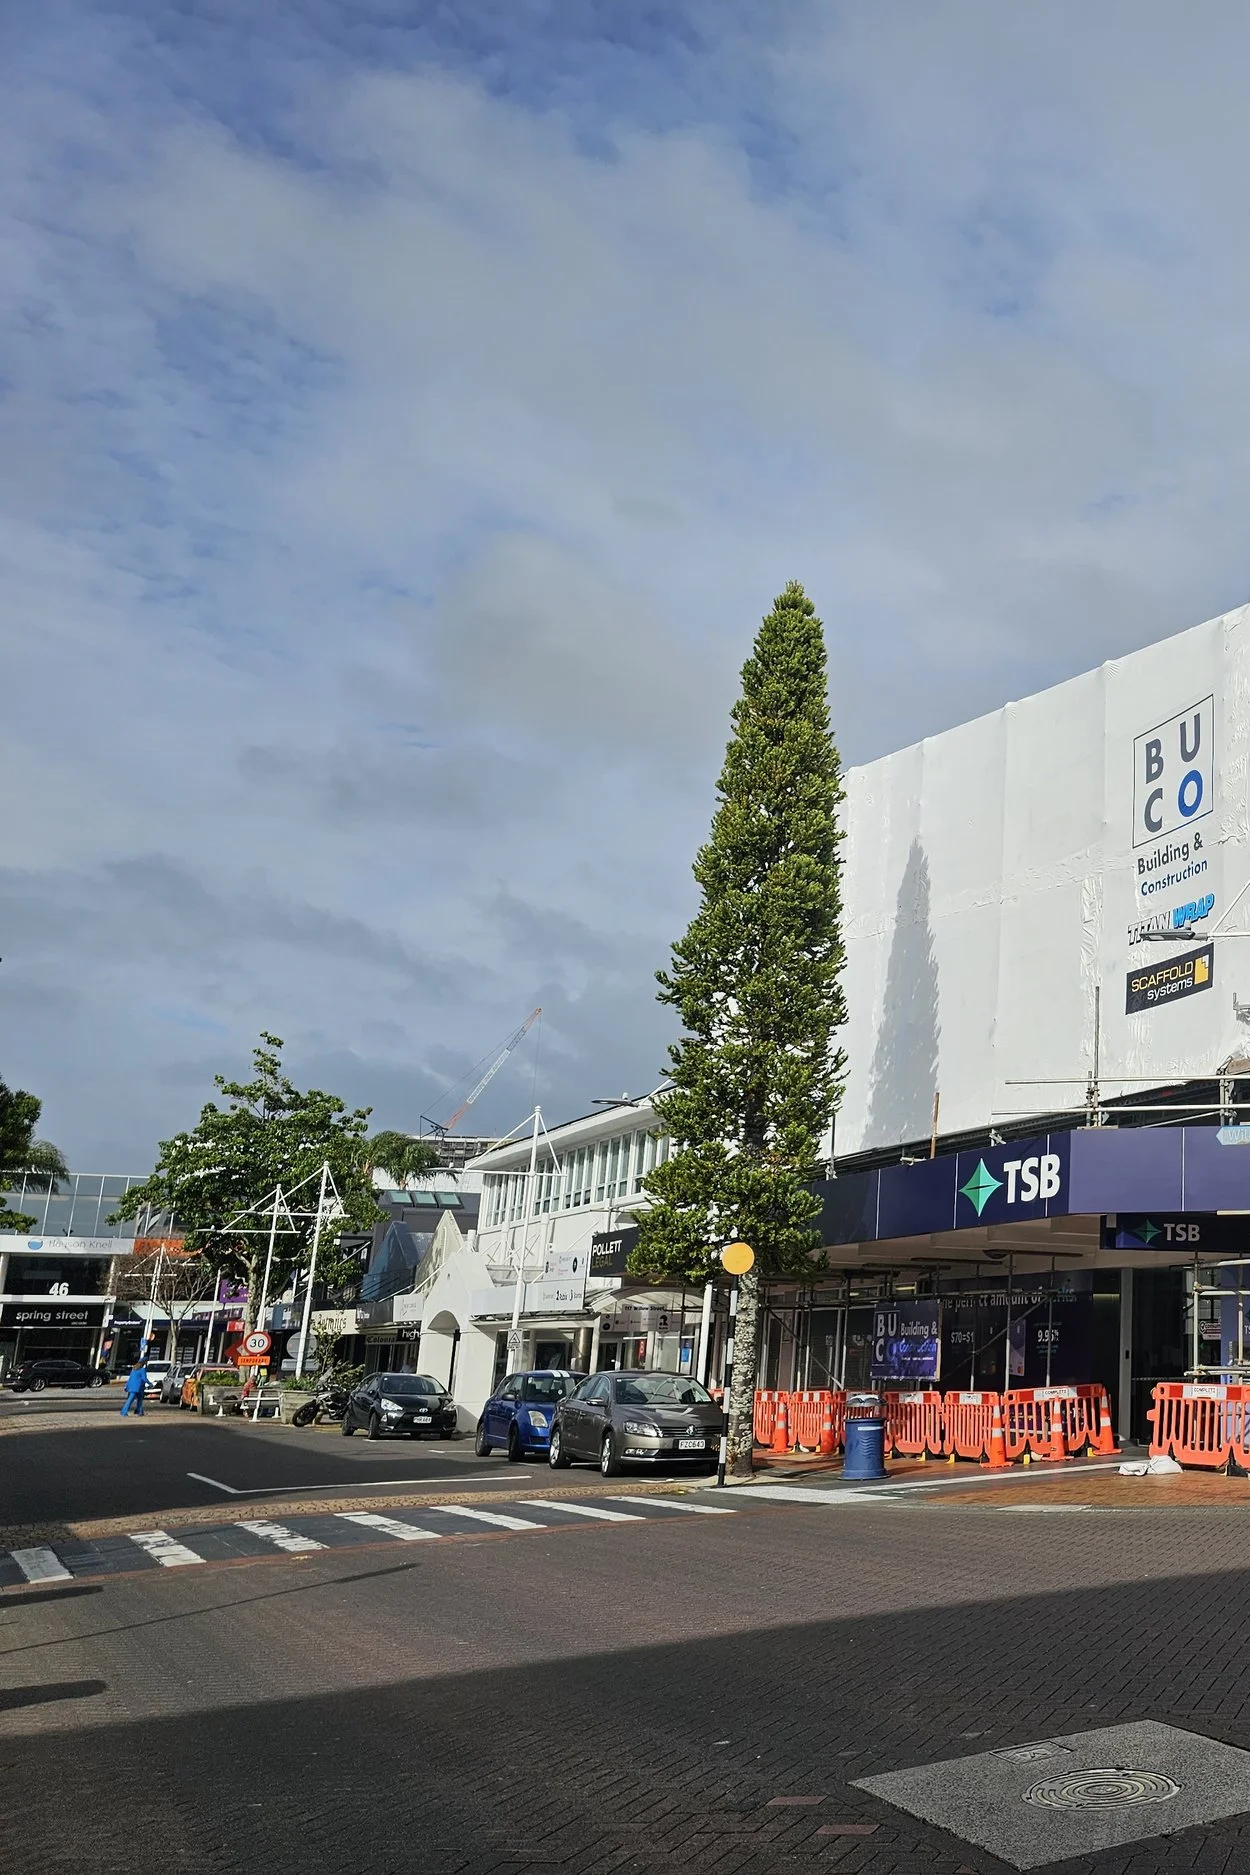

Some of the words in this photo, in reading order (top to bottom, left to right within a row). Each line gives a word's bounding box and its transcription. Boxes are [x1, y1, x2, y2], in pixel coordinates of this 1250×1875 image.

[1137, 840, 1189, 875] Building
[1193, 832, 1203, 850] &
[1141, 859, 1208, 896] Construction
[1127, 911, 1171, 946] TITAN
[1172, 893, 1215, 929] WRAP
[1131, 961, 1194, 993] SCAFFOLD
[1147, 977, 1193, 1001] systems
[1003, 1153, 1061, 1204] TSB
[1163, 1223, 1200, 1242] TSB
[592, 1239, 623, 1256] POLLETT
[592, 1255, 613, 1268] LEGAL
[49, 1281, 70, 1296] 46
[16, 1310, 51, 1322] spring
[55, 1310, 89, 1320] street
[900, 1320, 929, 1339] Building
[930, 1320, 938, 1336] &
[249, 1338, 265, 1348] 30
